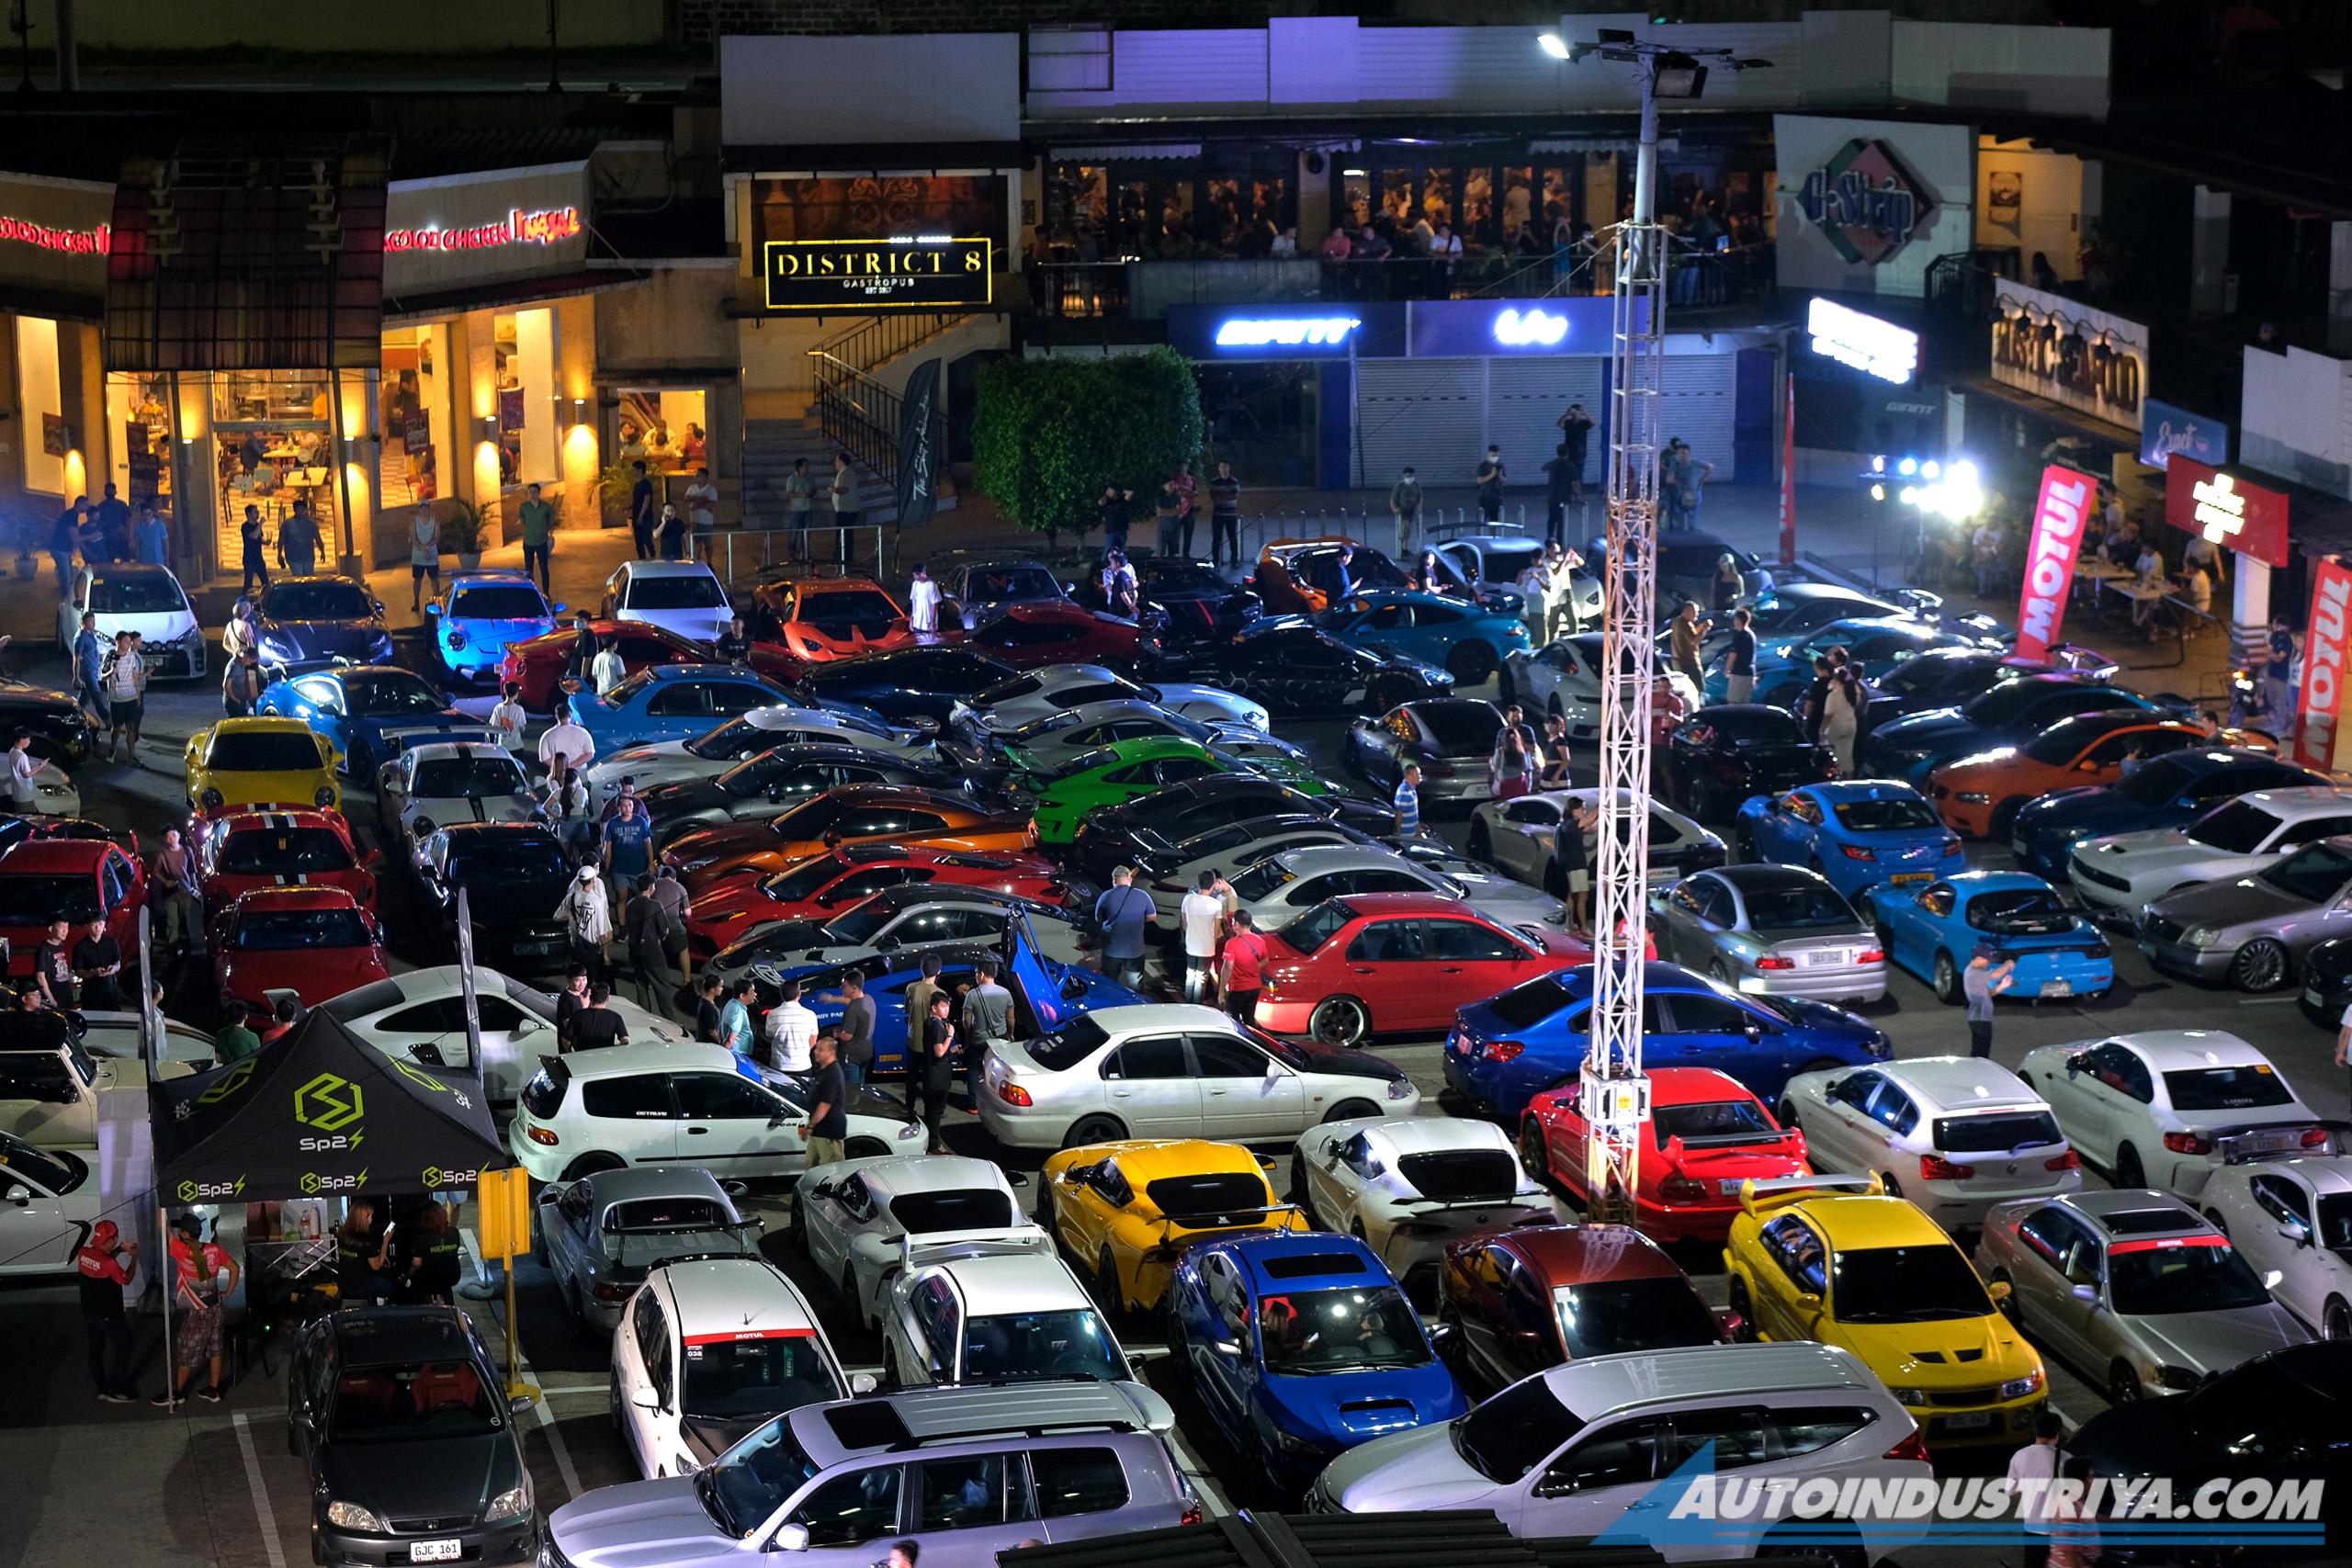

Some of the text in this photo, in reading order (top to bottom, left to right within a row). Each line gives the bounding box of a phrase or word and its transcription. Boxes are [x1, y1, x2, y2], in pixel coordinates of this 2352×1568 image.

[443, 223, 511, 251] CHICKEN
[511, 208, 582, 244] INASAL
[39, 229, 95, 254] CHICKEN
[778, 250, 981, 276] DISTRICT 8
[842, 277, 915, 288] GASTROPUB
[2023, 479, 2087, 644] MOTUL
[2303, 575, 2351, 763] MOTUL
[300, 1135, 347, 1151] Sp2
[322, 1175, 355, 1190] Sp2
[443, 1169, 476, 1183] Sp2
[198, 1181, 232, 1198] Sp2
[80, 1255, 101, 1269] MOTUL
[414, 1543, 458, 1557] GJC 161
